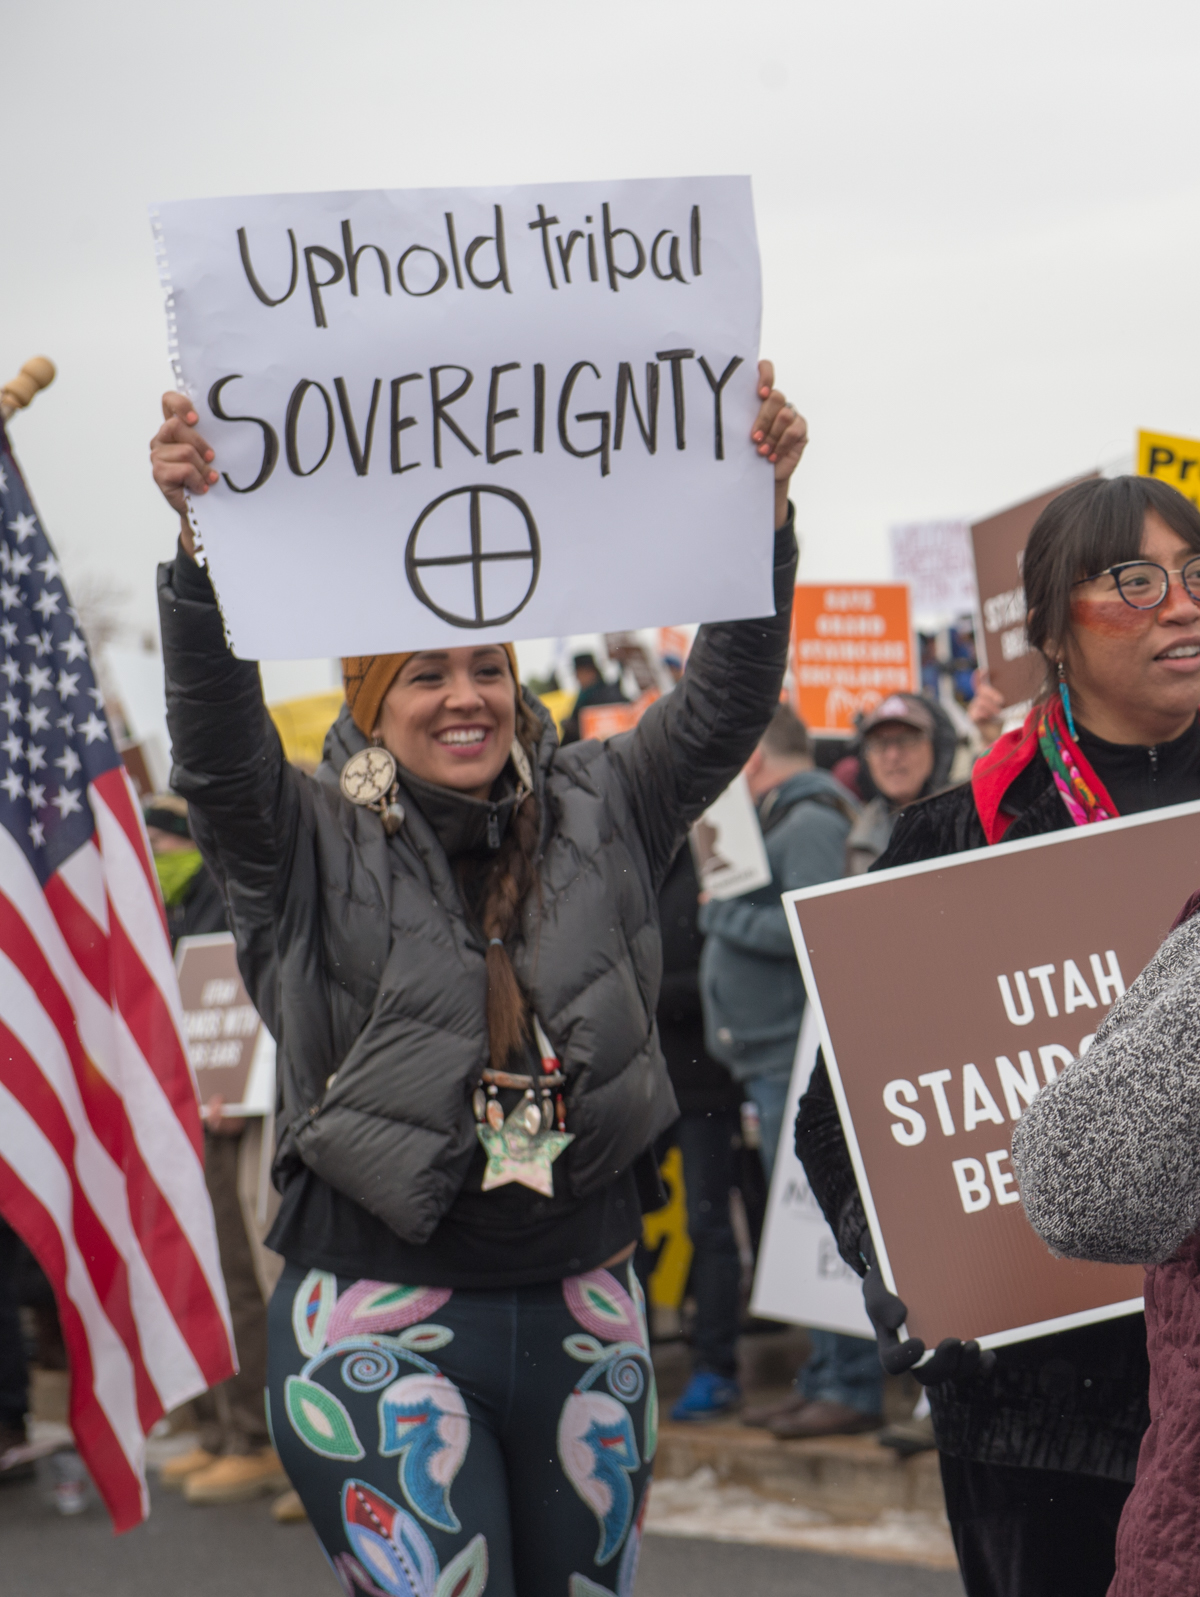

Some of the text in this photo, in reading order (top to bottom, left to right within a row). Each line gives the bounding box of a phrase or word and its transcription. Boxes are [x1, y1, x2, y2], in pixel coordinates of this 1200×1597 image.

[237, 203, 703, 328] Uphold tribal
[207, 349, 744, 494] SOVEREIGNTY
[996, 950, 1126, 1027] UTAH
